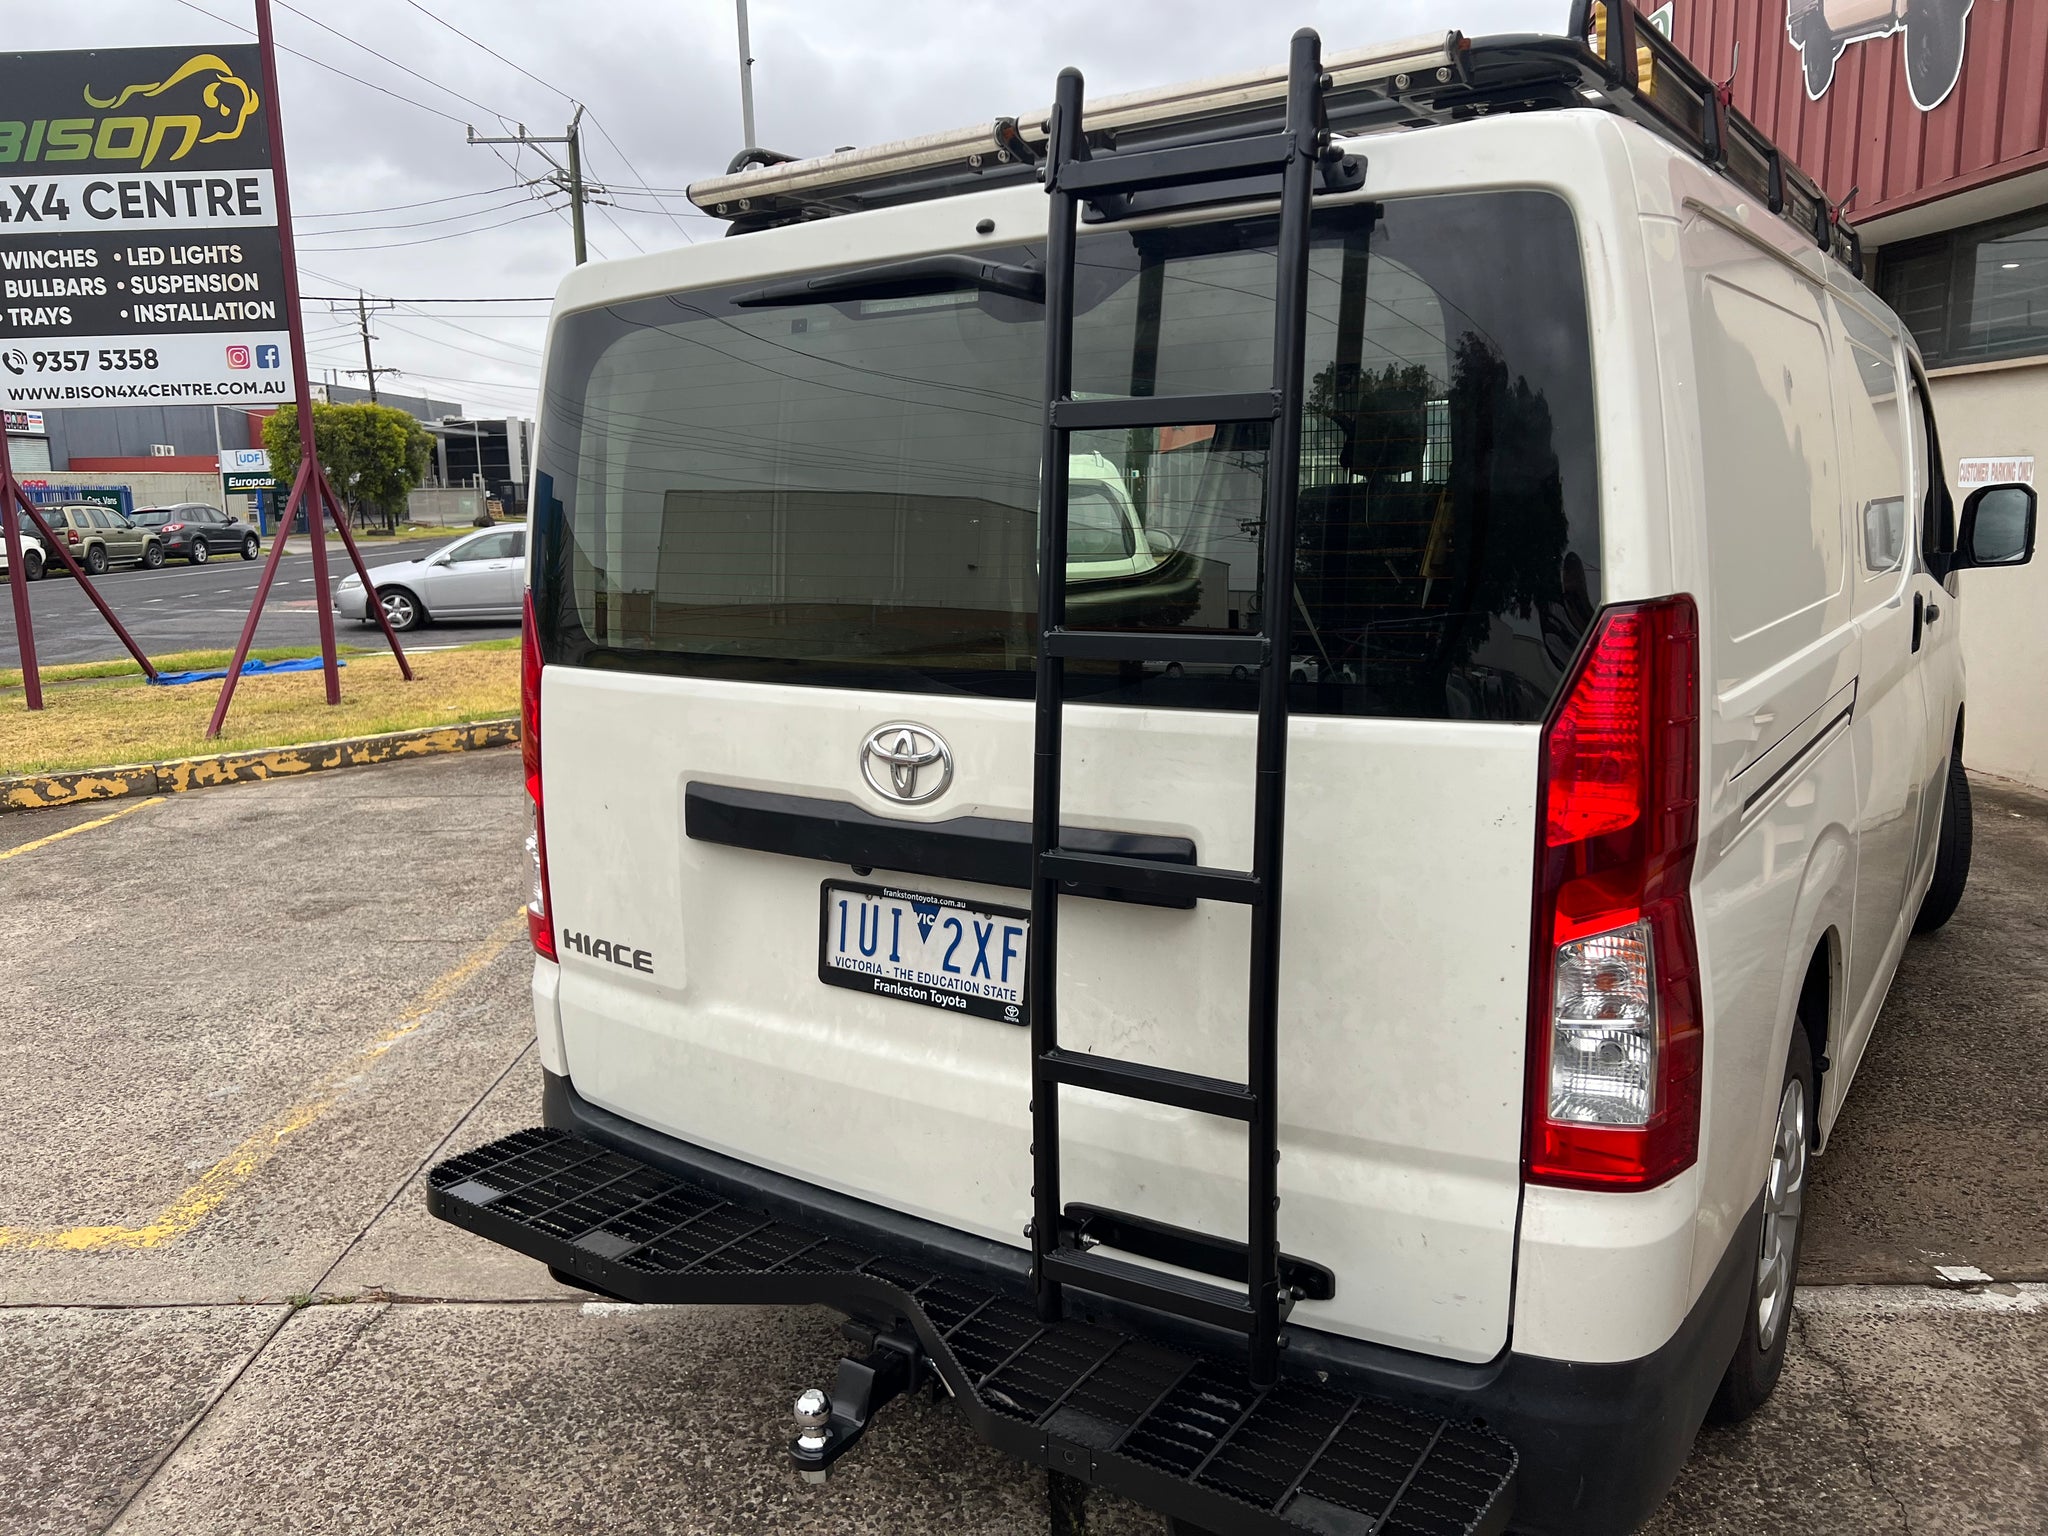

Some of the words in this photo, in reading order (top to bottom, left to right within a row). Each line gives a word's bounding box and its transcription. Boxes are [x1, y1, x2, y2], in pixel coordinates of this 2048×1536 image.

[82, 177, 262, 220] CENTRE
[1, 248, 99, 270] WINCHES
[127, 247, 165, 266] LED
[170, 244, 243, 265] LIGHTS
[5, 277, 107, 298] BULLBARS
[131, 273, 259, 295] SUSPENSION
[8, 306, 73, 326] TRAYS
[134, 301, 276, 322] INSTALLATION
[32, 350, 90, 372] 9357
[98, 348, 159, 371] 5358
[8, 381, 286, 401] WWW.BISON4X4CENTRE.COM.AU
[240, 453, 260, 463] UDF
[1960, 463, 1989, 482] CUSTOMER
[1991, 462, 2016, 481] PARKING
[2018, 461, 2034, 481] ONLY
[228, 477, 276, 488] Europcar
[883, 888, 966, 909] frankstontoyota.com.au
[914, 911, 936, 926] VIC
[563, 928, 654, 974] HIACE
[838, 899, 902, 962] 1UI
[942, 917, 1023, 983] 2XF
[835, 956, 883, 975] VICTORIA
[894, 967, 914, 981] THE
[918, 972, 980, 994] EDUCATION
[984, 984, 1017, 1002] STATE
[873, 978, 928, 1001] Frankston
[929, 990, 967, 1009] Toyota
